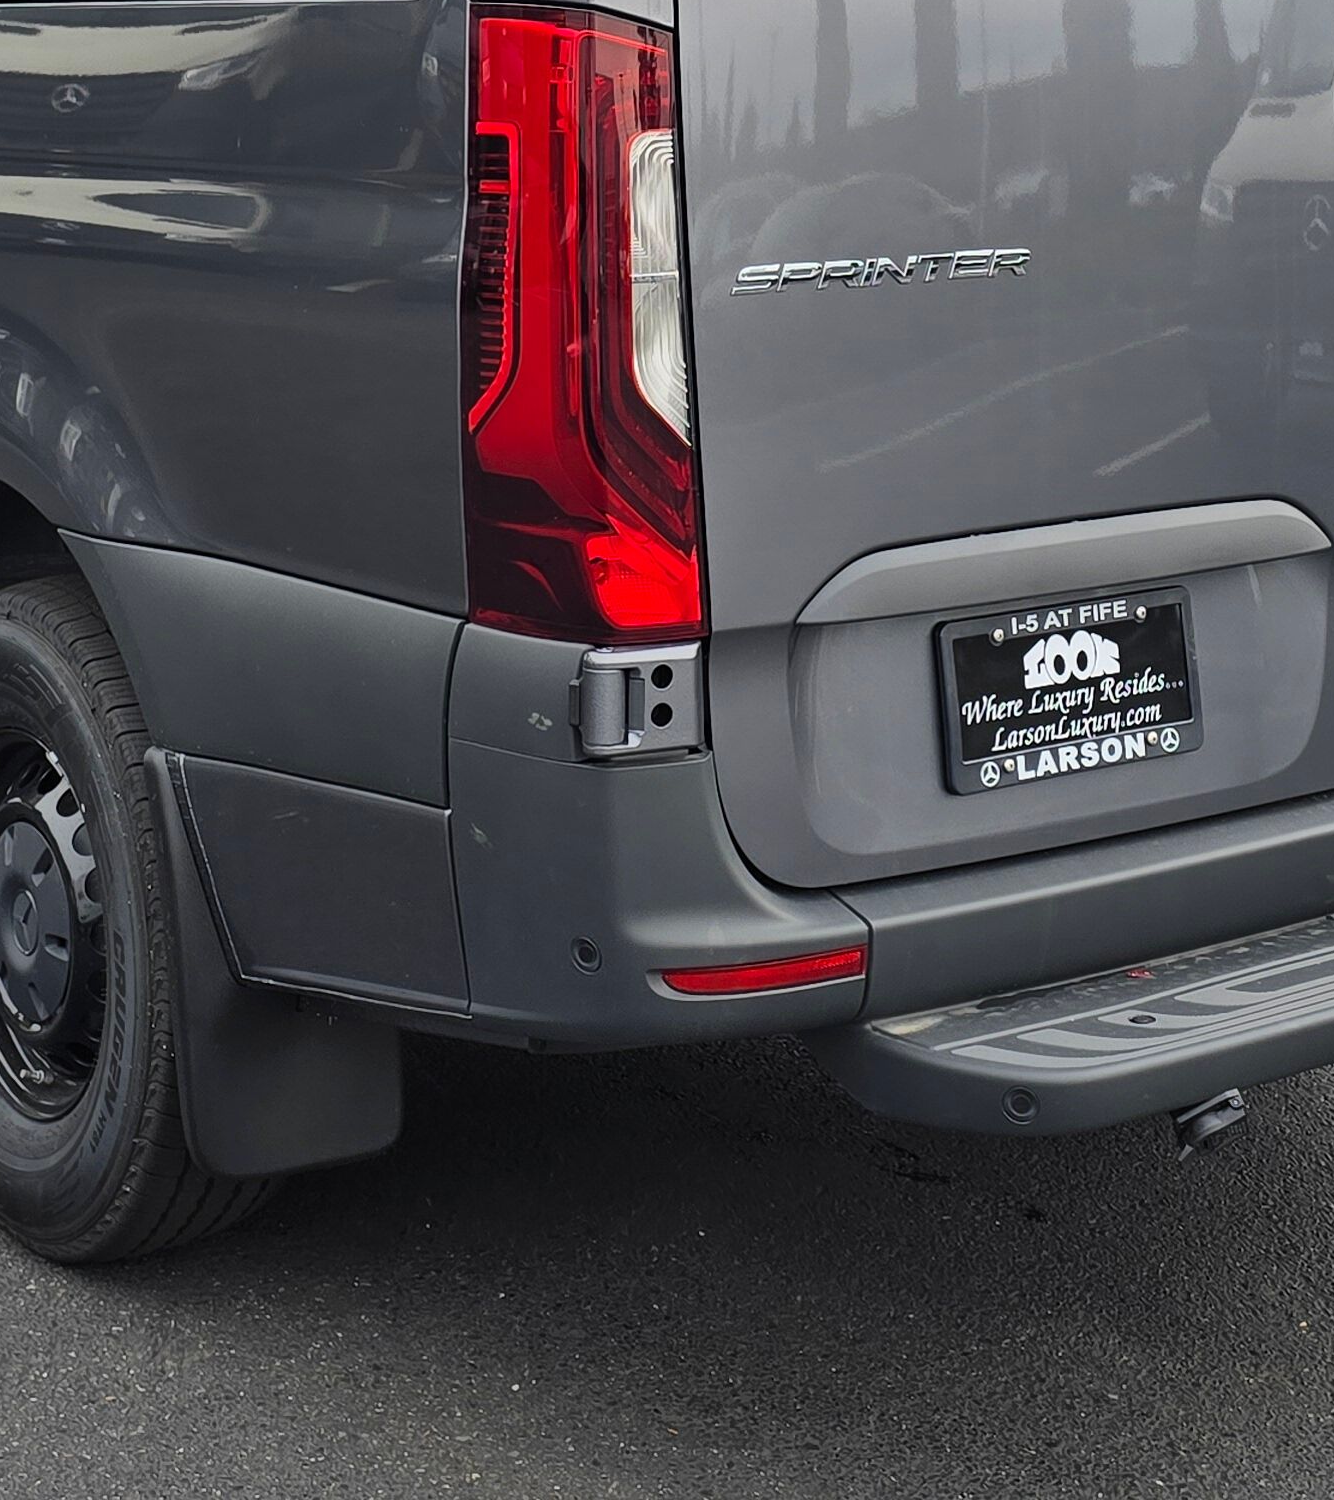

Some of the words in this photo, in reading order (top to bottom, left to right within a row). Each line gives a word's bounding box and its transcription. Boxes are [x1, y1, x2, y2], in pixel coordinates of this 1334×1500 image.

[730, 247, 1033, 297] SPRINTER
[1011, 615, 1039, 636] I-5
[1043, 608, 1072, 631] AT
[1079, 600, 1128, 624] FIFE
[961, 693, 1024, 726] Where
[1028, 684, 1095, 714] Luxury
[991, 702, 1163, 752] LarsonLuxury.com
[1016, 732, 1147, 781] LARSON
